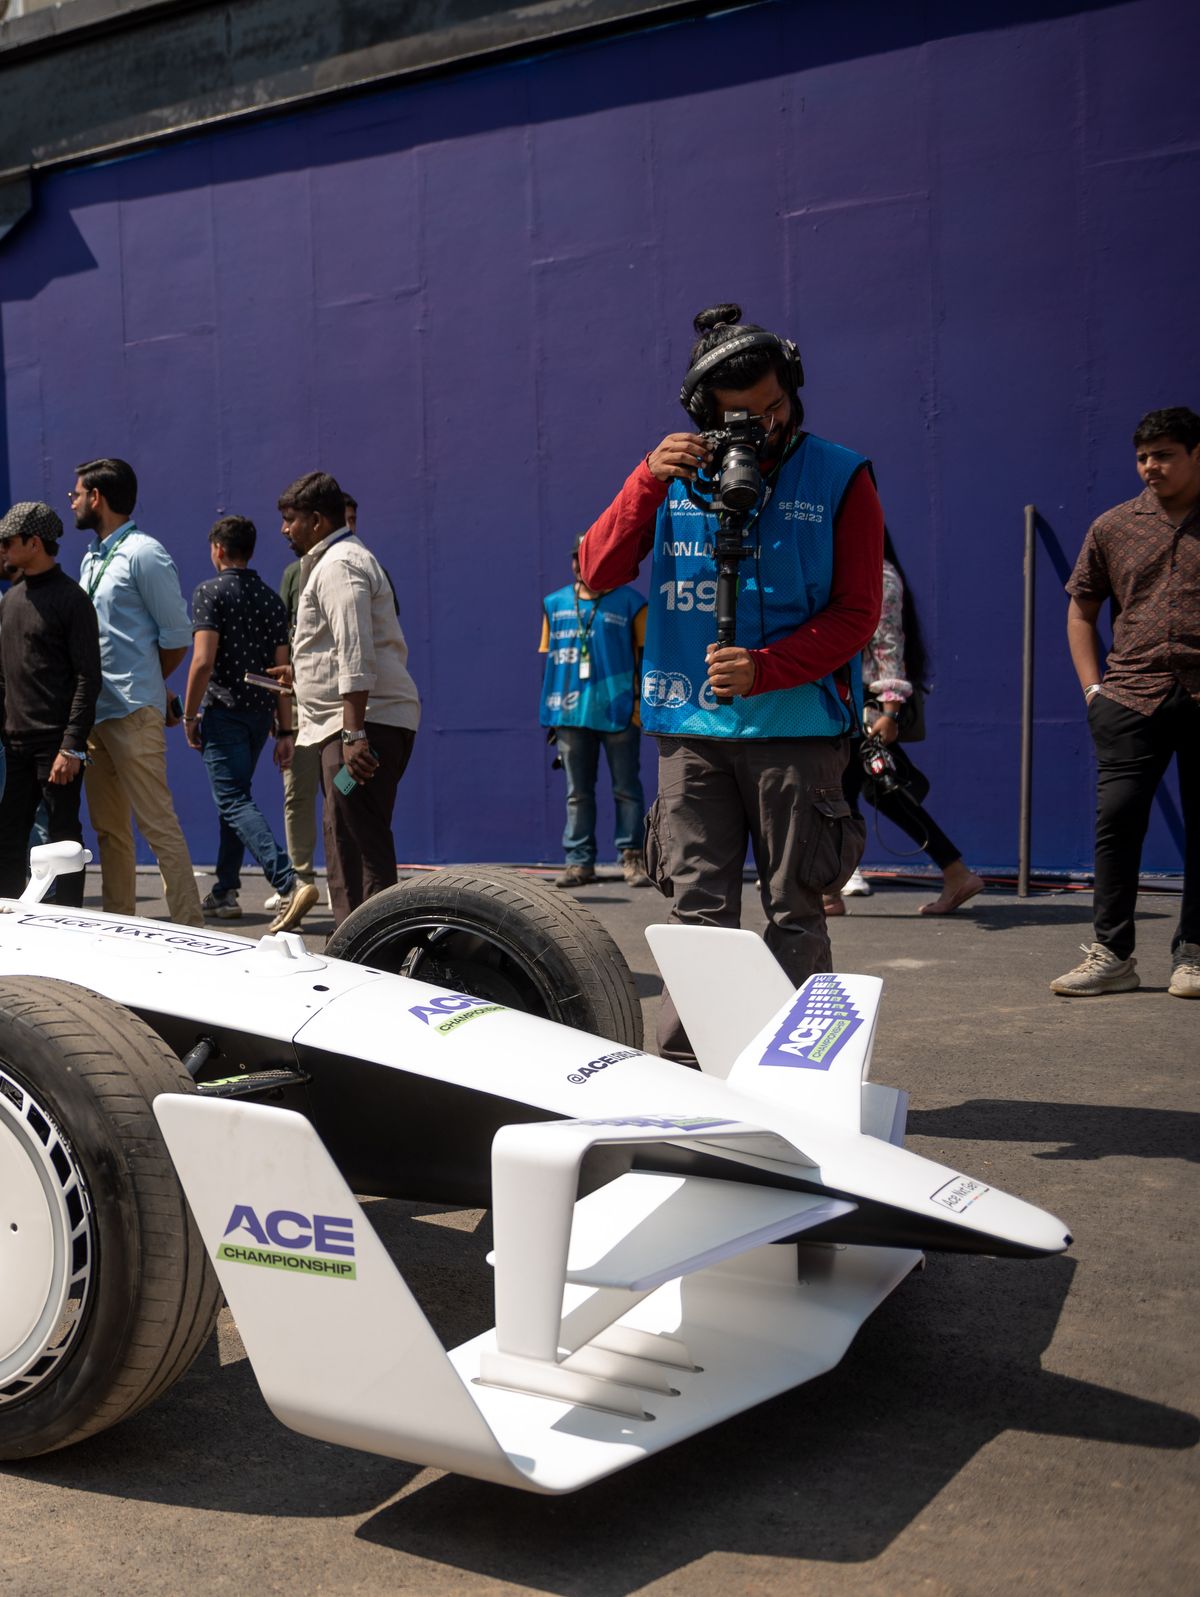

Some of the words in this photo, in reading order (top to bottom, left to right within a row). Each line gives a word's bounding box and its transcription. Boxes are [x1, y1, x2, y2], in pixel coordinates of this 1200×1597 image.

[779, 501, 814, 511] SESON
[663, 542, 692, 557] NON
[660, 581, 718, 611] 159
[40, 915, 101, 928] Ace
[103, 925, 163, 939] Nxt
[165, 935, 230, 952] Gen
[408, 994, 492, 1025] ACE
[778, 1017, 833, 1057] ACE
[223, 1204, 355, 1257] ACE
[224, 1247, 352, 1275] CHAMPIONSHIP
